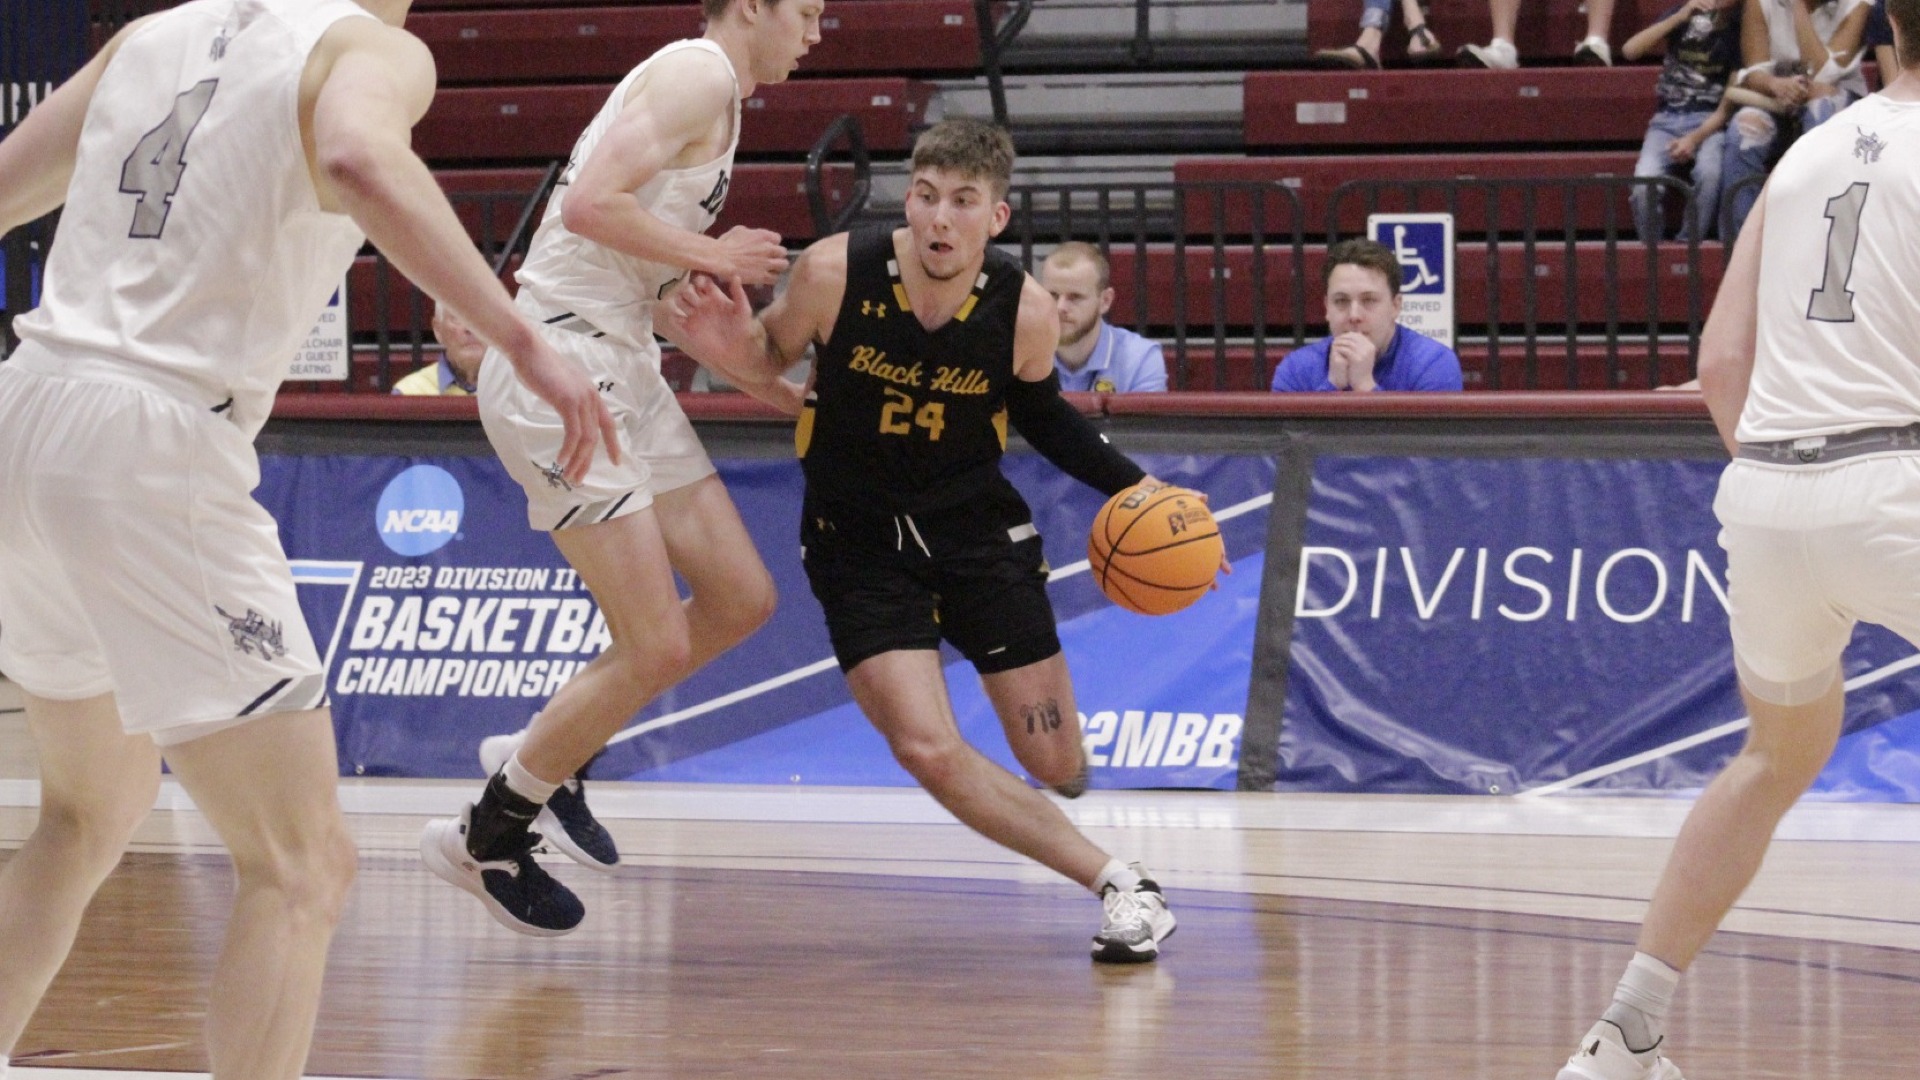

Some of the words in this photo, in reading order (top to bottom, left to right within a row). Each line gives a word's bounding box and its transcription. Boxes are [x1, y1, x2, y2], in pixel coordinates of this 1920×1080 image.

[119, 77, 219, 239] 4
[1806, 181, 1869, 322] 1
[1402, 301, 1442, 312] ERVED
[849, 344, 923, 387] Black
[929, 366, 990, 395] Hills
[879, 386, 945, 441] 24
[383, 509, 459, 534] NCAA
[369, 566, 432, 589] 2023
[433, 567, 550, 591] DIVISION
[349, 595, 614, 654] BASKETBA
[335, 657, 588, 698] CHAMPIONSH
[1076, 710, 1243, 768] 2MBB
